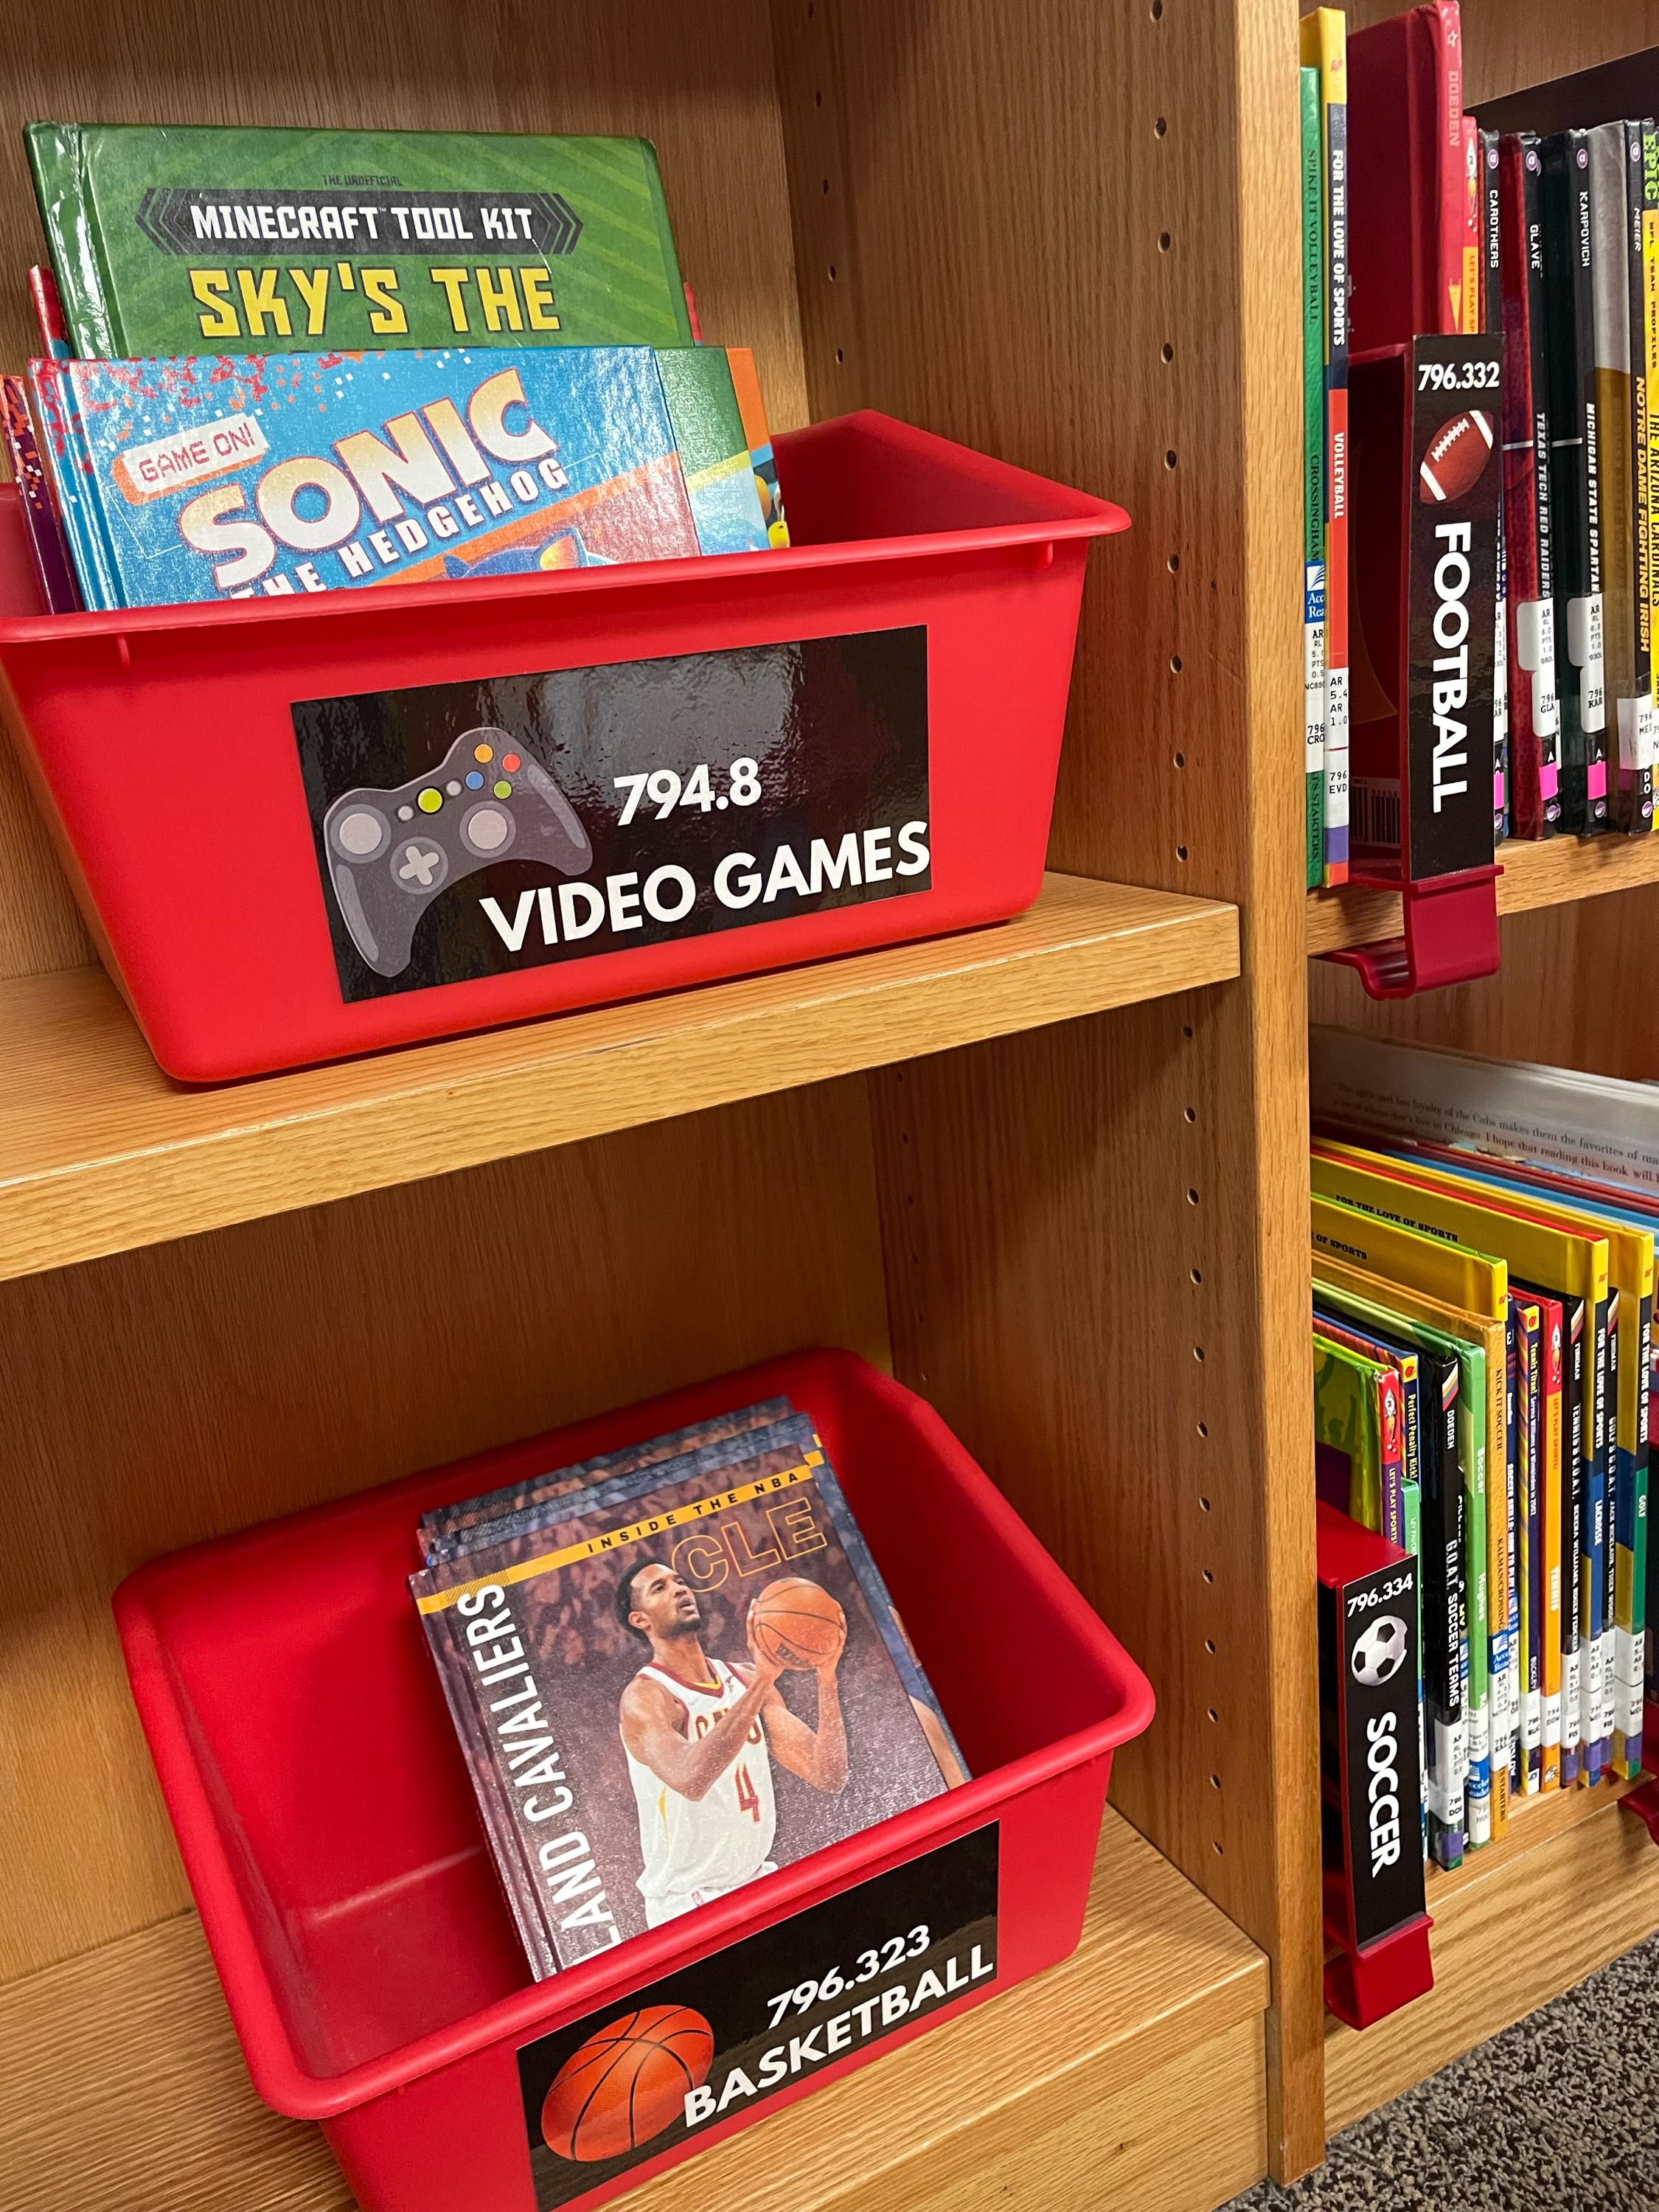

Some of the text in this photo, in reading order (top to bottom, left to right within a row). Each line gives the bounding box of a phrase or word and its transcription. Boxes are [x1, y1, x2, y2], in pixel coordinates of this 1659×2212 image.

[1448, 70, 1461, 146] DOEDEN
[321, 174, 402, 187] THE UNOFFICIAL
[1308, 150, 1318, 195] SPIKE
[391, 207, 473, 240] TOOL
[480, 207, 533, 240] KIT
[1489, 189, 1498, 268] CAROTHERS
[1529, 224, 1540, 270] GLAVE
[1579, 191, 1590, 268] KARPOVICH
[1309, 220, 1319, 325] VOLLEYBALL
[1332, 150, 1346, 347] FOR THE LOVE OF SPORTS
[187, 260, 562, 338] SKY'S THE
[1418, 362, 1500, 392] 796.332
[139, 422, 257, 483] GAME ON!
[1333, 431, 1345, 519] VOLLEYBALL
[178, 368, 560, 589] SONIC
[1586, 403, 1601, 595] MICHIGAN STATE SPARTAN
[337, 459, 569, 579] HEDGEHOG
[1537, 413, 1551, 598] TEXAS TECH RED RAIDERS
[1636, 377, 1650, 653] NOTRE DAME FIGHTING IRISH
[1650, 414, 1659, 608] THE ARIZONA CARDINALS
[1542, 608, 1551, 619] AR
[1590, 605, 1600, 615] AR
[1330, 677, 1343, 686] AR
[1433, 521, 1472, 813] FOOTBALL
[1330, 689, 1348, 699] 5.4
[1330, 704, 1343, 713] AR
[1540, 703, 1554, 713] GLA
[1541, 694, 1554, 705] 796
[1588, 697, 1603, 709] KAR
[1589, 687, 1603, 700] 796
[1639, 712, 1652, 723] 796
[1307, 723, 1324, 735] 796
[1307, 734, 1325, 745] CRO
[1330, 716, 1348, 726] 1.0
[612, 755, 762, 827] 794.8
[1329, 771, 1348, 781] 796
[1329, 784, 1348, 794] EVD
[479, 821, 931, 953] VIDEO GAMES
[1456, 1108, 1470, 1121] the
[1472, 1113, 1497, 1127] Cubs
[1499, 1121, 1529, 1136] makes
[1532, 1127, 1557, 1141] them
[1561, 1133, 1576, 1144] the
[1580, 1137, 1624, 1156] favorites
[1627, 1150, 1639, 1161] of
[1492, 1133, 1513, 1149] hope
[1518, 1139, 1537, 1153] that
[1541, 1147, 1578, 1164] reading
[1581, 1155, 1599, 1169] this
[1603, 1160, 1629, 1177] book
[1633, 1169, 1652, 1182] will
[1316, 1234, 1368, 1259] OF SPORTS
[1355, 1202, 1374, 1214] THE
[1377, 1208, 1401, 1222] LOVE
[1403, 1217, 1416, 1228] OF
[1419, 1222, 1458, 1242] SPORTS
[1496, 1397, 1503, 1407] IT
[1408, 1394, 1418, 1479] Perfect Penalty Kick!
[1447, 1409, 1455, 1450] DOEDEN
[1477, 1447, 1485, 1494] Soccer
[587, 1472, 799, 1553] INSIDE THE NBA
[672, 1497, 828, 1593] CLE
[1347, 1573, 1413, 1618] 796.334
[1478, 1571, 1487, 1621] Hughes
[1551, 1565, 1559, 1612] TENNIS
[1445, 1539, 1460, 1707] G.O.A.T. SOCCER TEAMS
[456, 1584, 574, 1823] CAVALIERS
[735, 1763, 759, 1822] 4
[1366, 1711, 1401, 1878] SOCCER
[766, 1924, 931, 2030] 796.323
[684, 1944, 994, 2127] BASKETBALL
